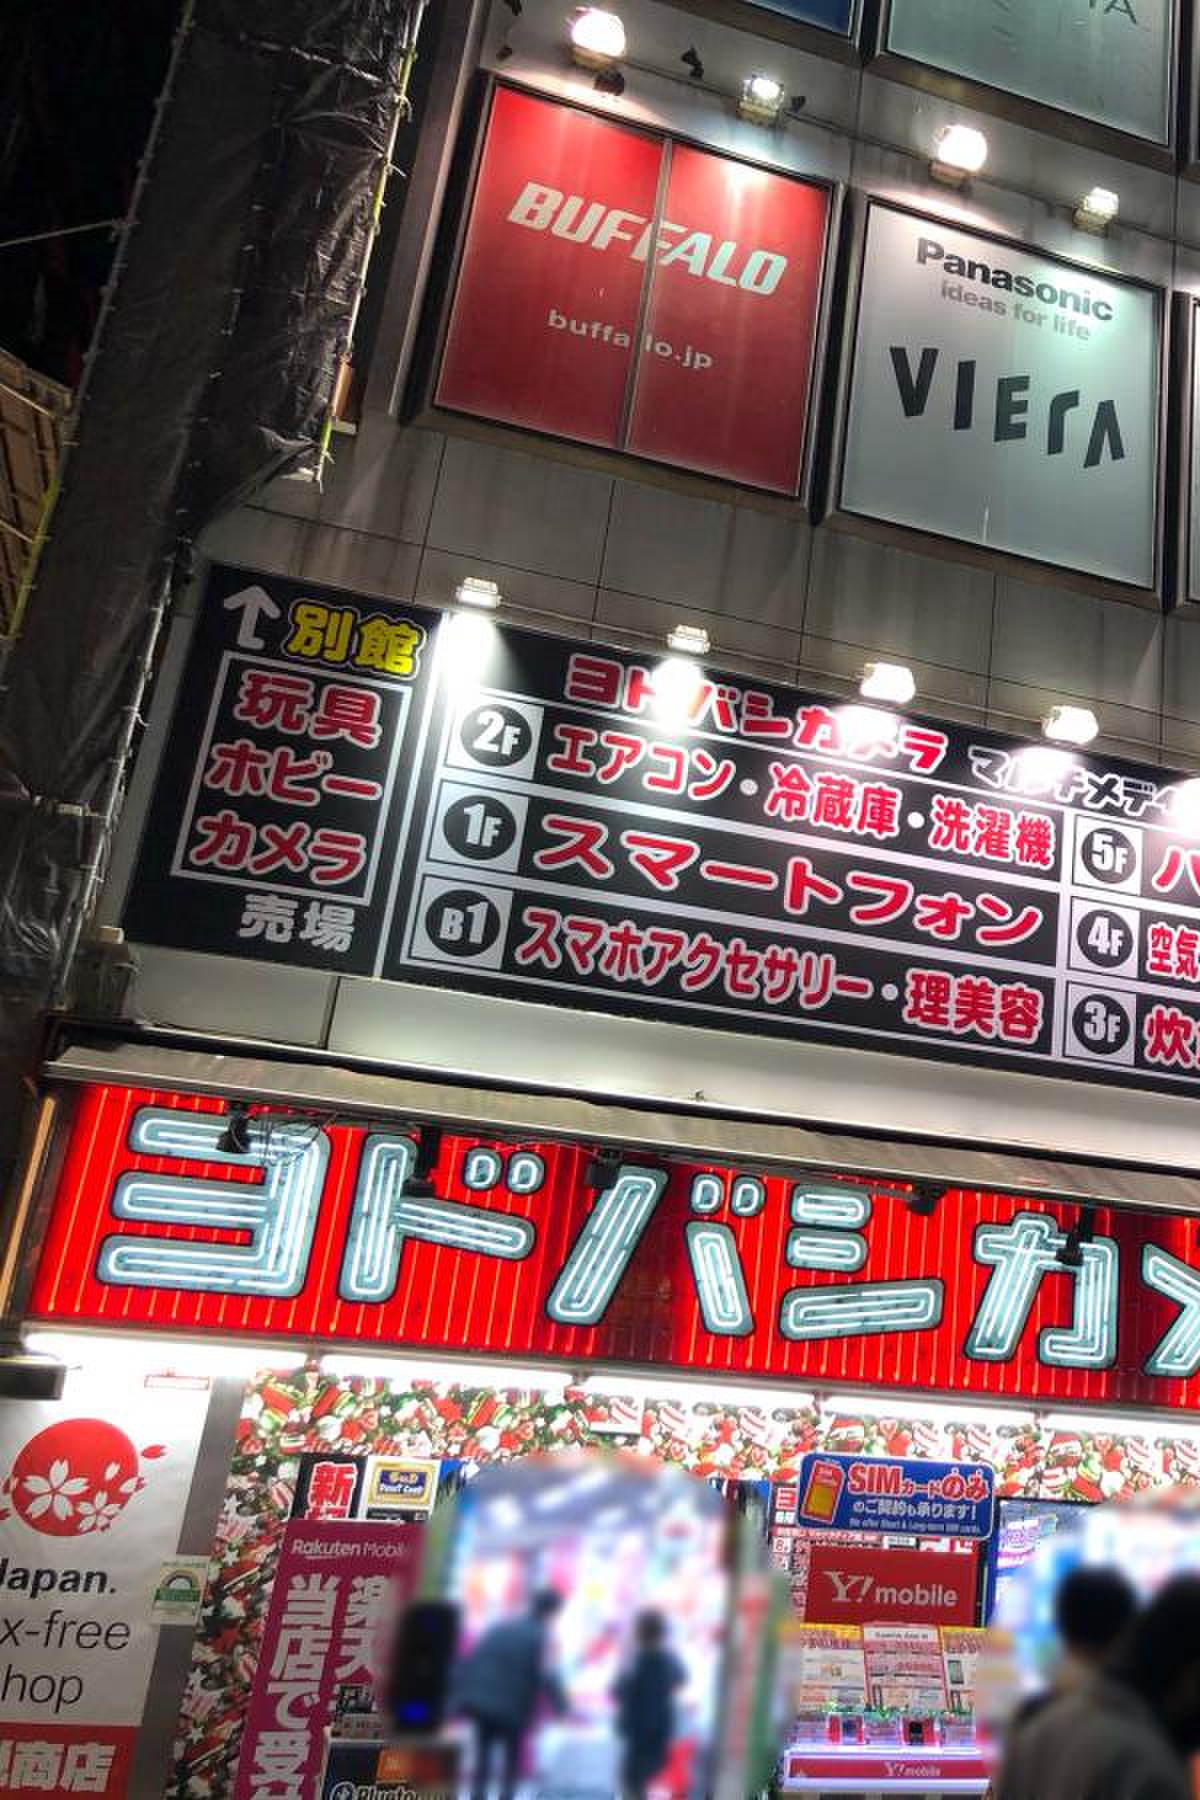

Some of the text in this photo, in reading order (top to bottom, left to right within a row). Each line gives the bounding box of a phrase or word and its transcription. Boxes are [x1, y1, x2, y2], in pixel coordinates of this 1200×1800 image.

[508, 182, 788, 296] BUFFALO
[917, 237, 1114, 323] Panasonic
[940, 280, 1093, 343] ideas for life
[547, 308, 713, 371] buffalo.jp
[288, 600, 425, 679] 別館
[234, 671, 383, 749] 玩具
[473, 708, 520, 756] 2F
[563, 653, 946, 772] ヨドバシカラ
[204, 739, 382, 806] ホビー
[189, 810, 368, 886] カメラ
[462, 801, 503, 846] 1F
[1091, 833, 1128, 873] 5F
[533, 812, 1045, 945] スマートフォン
[239, 894, 356, 954] 売場
[438, 900, 489, 946] B1
[1088, 916, 1123, 957] 4F
[1084, 1001, 1122, 1042] 3F
[250, 1572, 342, 1800] 当店で受
[0, 1739, 117, 1793] 商店
